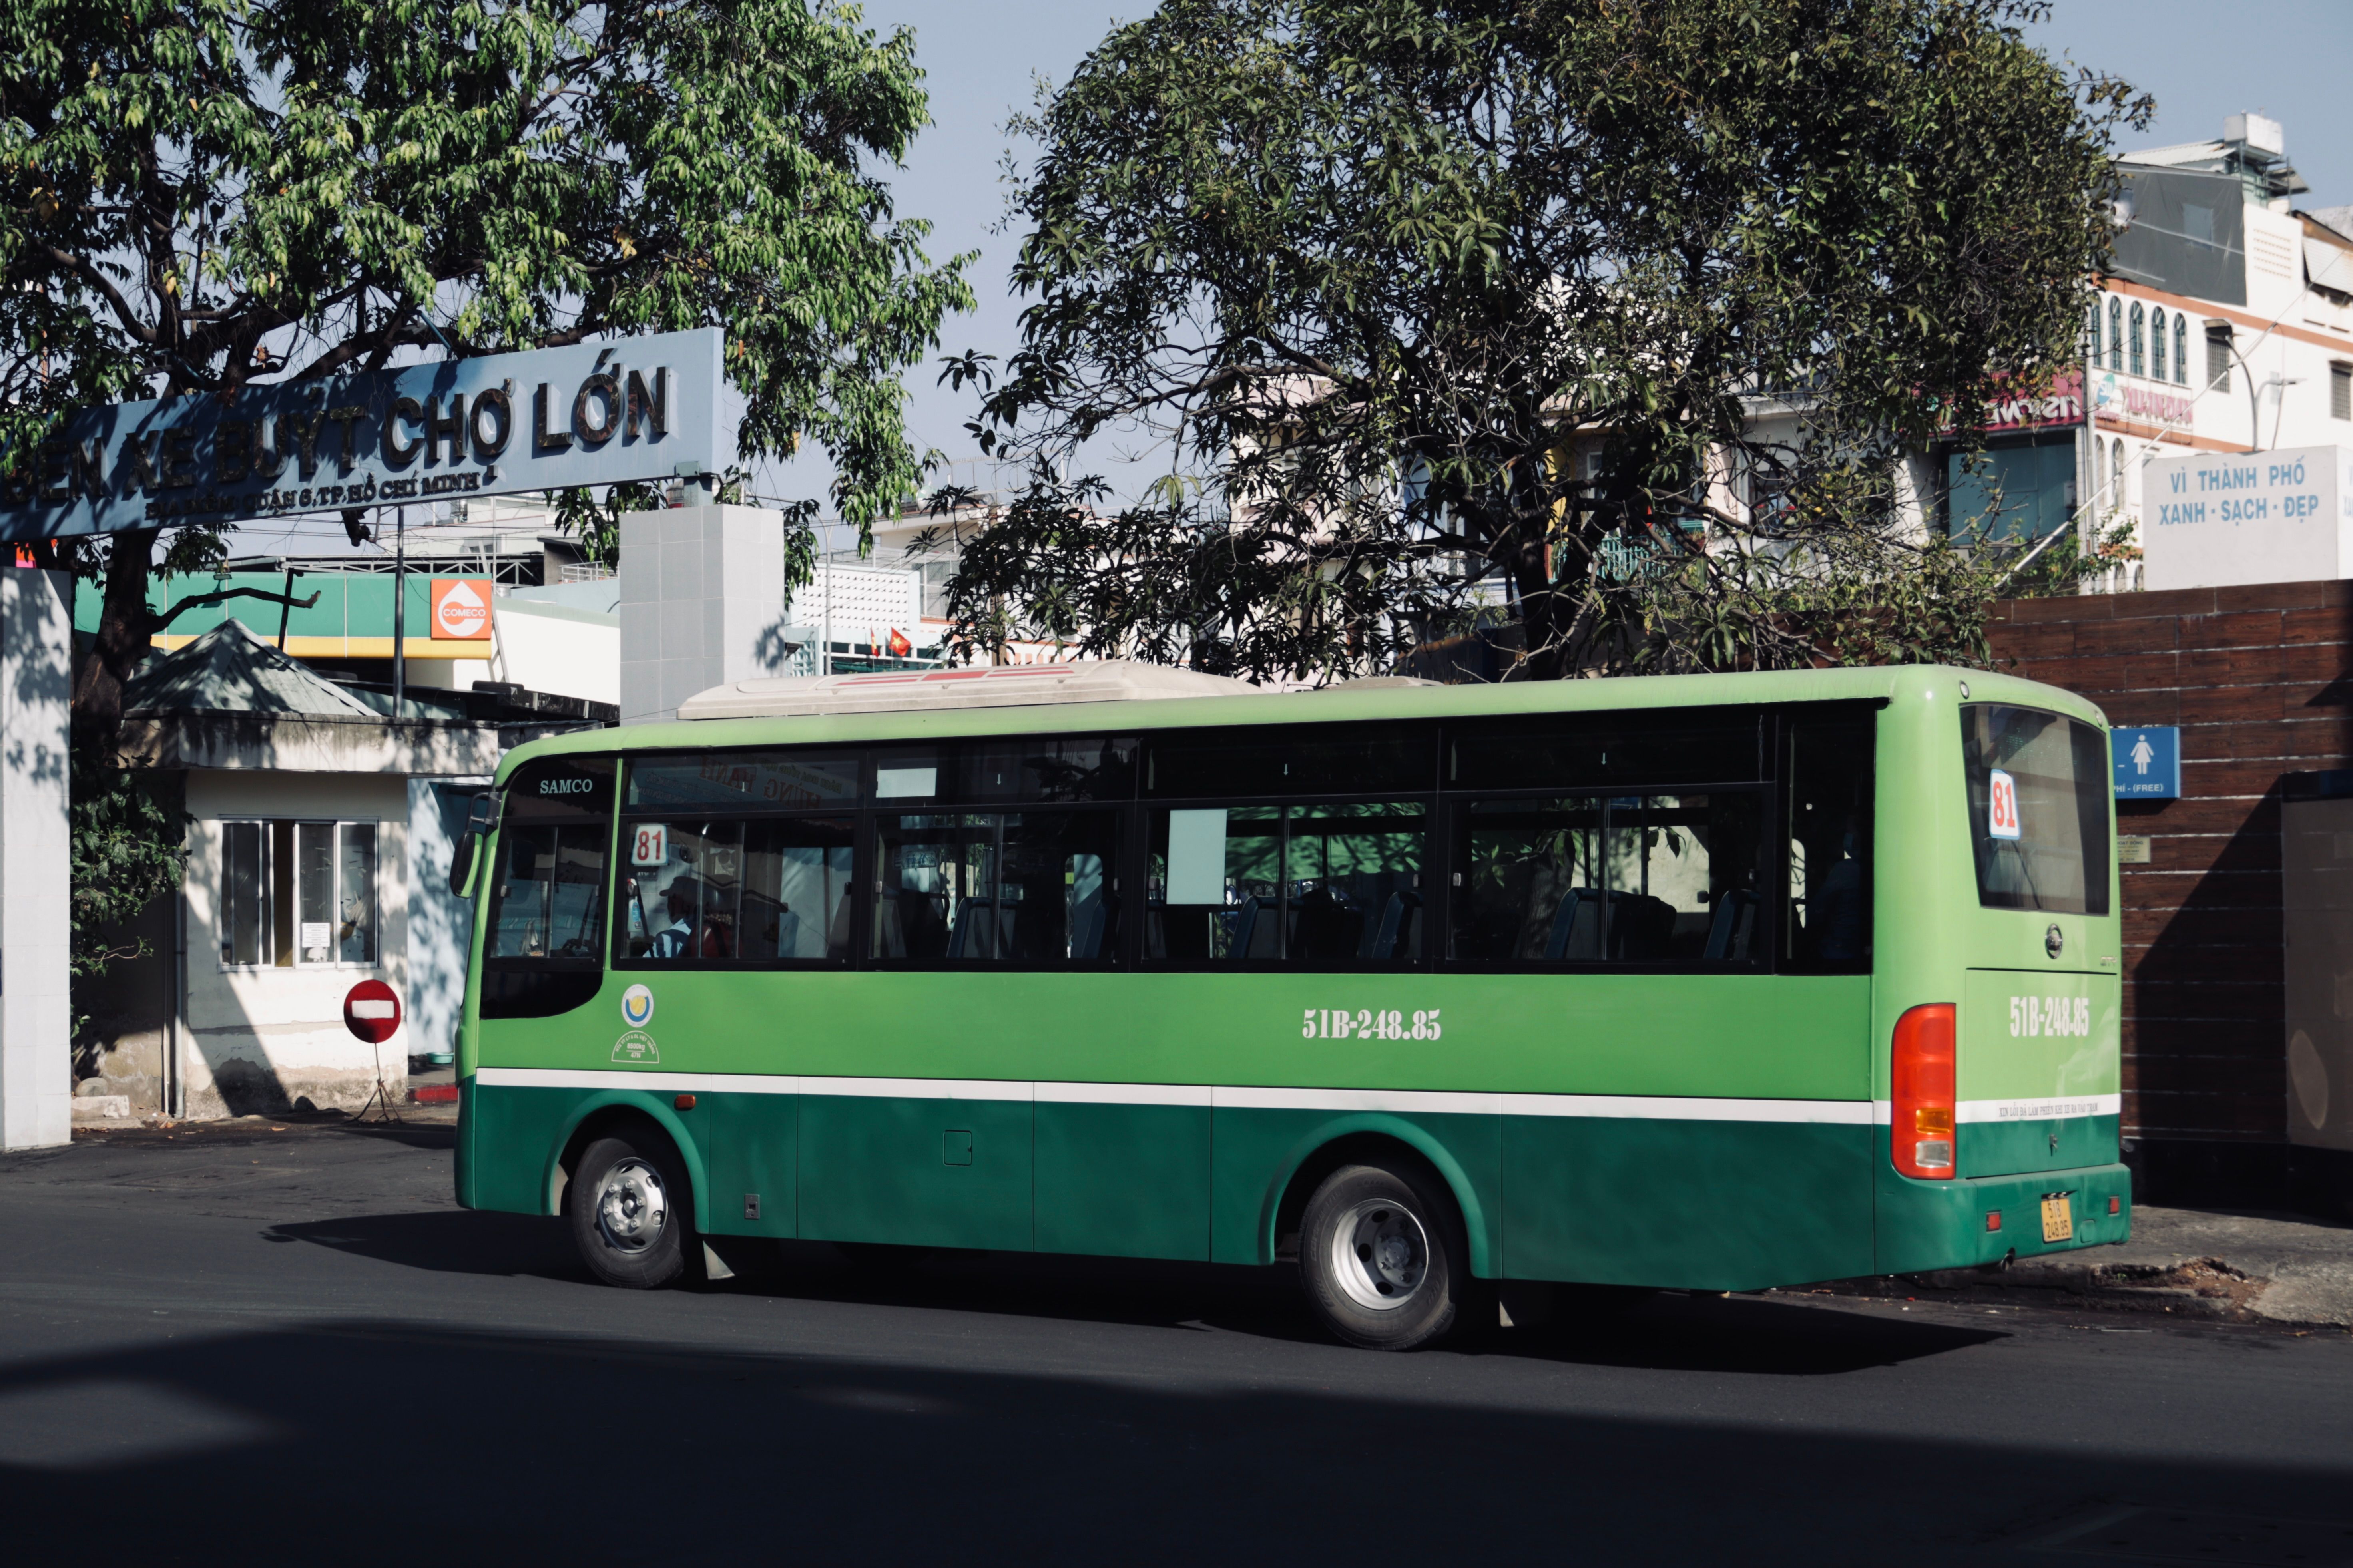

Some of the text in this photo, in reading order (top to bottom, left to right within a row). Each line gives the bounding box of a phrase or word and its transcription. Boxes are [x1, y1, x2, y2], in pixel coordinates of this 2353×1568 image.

[125, 427, 195, 492] XE
[216, 387, 367, 483] BUÝT
[384, 378, 516, 479] CHỢ
[536, 348, 671, 448] LỚN
[2170, 454, 2305, 494] VÌ THÀNH PHỐ
[241, 488, 297, 516] QUẬN
[380, 470, 419, 498] CHÍ
[422, 472, 481, 494] MINH
[2159, 495, 2319, 526] XANH SẠCH ĐẸP
[443, 608, 486, 617] COMECO
[540, 778, 593, 794] SAMCO
[2133, 783, 2164, 793] (FREE)
[1992, 780, 2016, 828] 81
[637, 829, 662, 861] 81
[1302, 1008, 1442, 1041] 51B-248.85
[2010, 996, 2090, 1037] 51B-248.85
[626, 1043, 646, 1051] 8500kg
[1999, 1107, 2008, 1117] XIN
[2064, 1104, 2070, 1114] XE
[2071, 1104, 2077, 1113] RA
[2047, 1201, 2061, 1219] 51B
